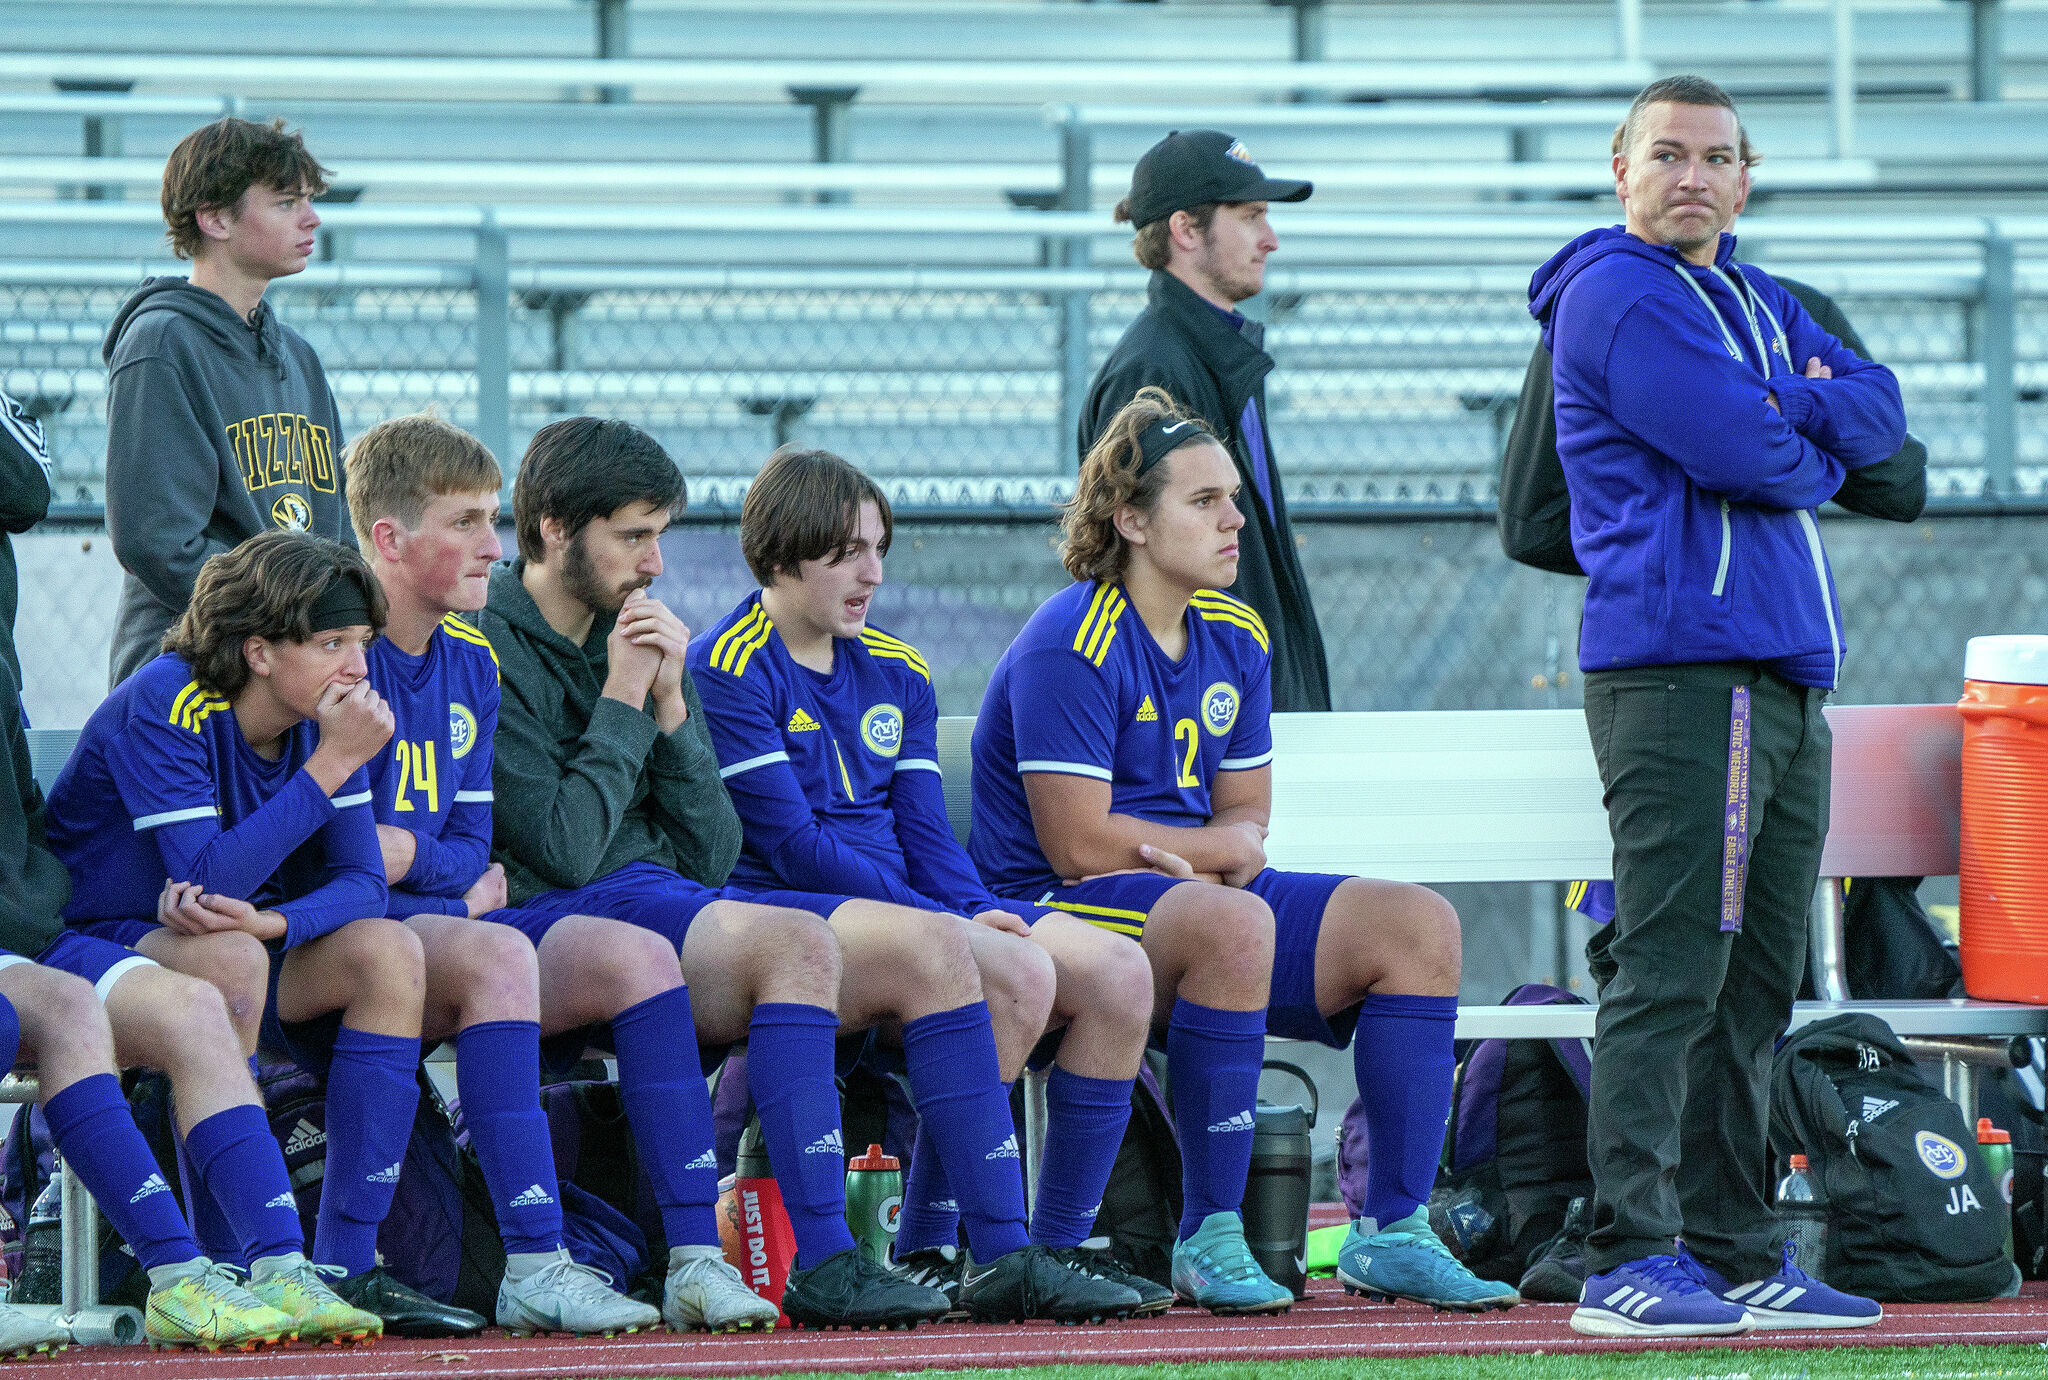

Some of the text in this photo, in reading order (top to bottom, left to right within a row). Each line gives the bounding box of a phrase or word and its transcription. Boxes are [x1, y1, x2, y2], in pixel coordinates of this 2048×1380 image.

[787, 721, 821, 733] adidas
[395, 739, 439, 813] 24
[1728, 719, 1743, 805] CIVIC MEMORIAL
[1723, 836, 1737, 921] EAGLE ATHLETICS
[509, 1196, 554, 1208] adidas
[877, 1195, 902, 1234] G
[1945, 1184, 1982, 1215] JA
[742, 1189, 771, 1294] JUST DO IT.
